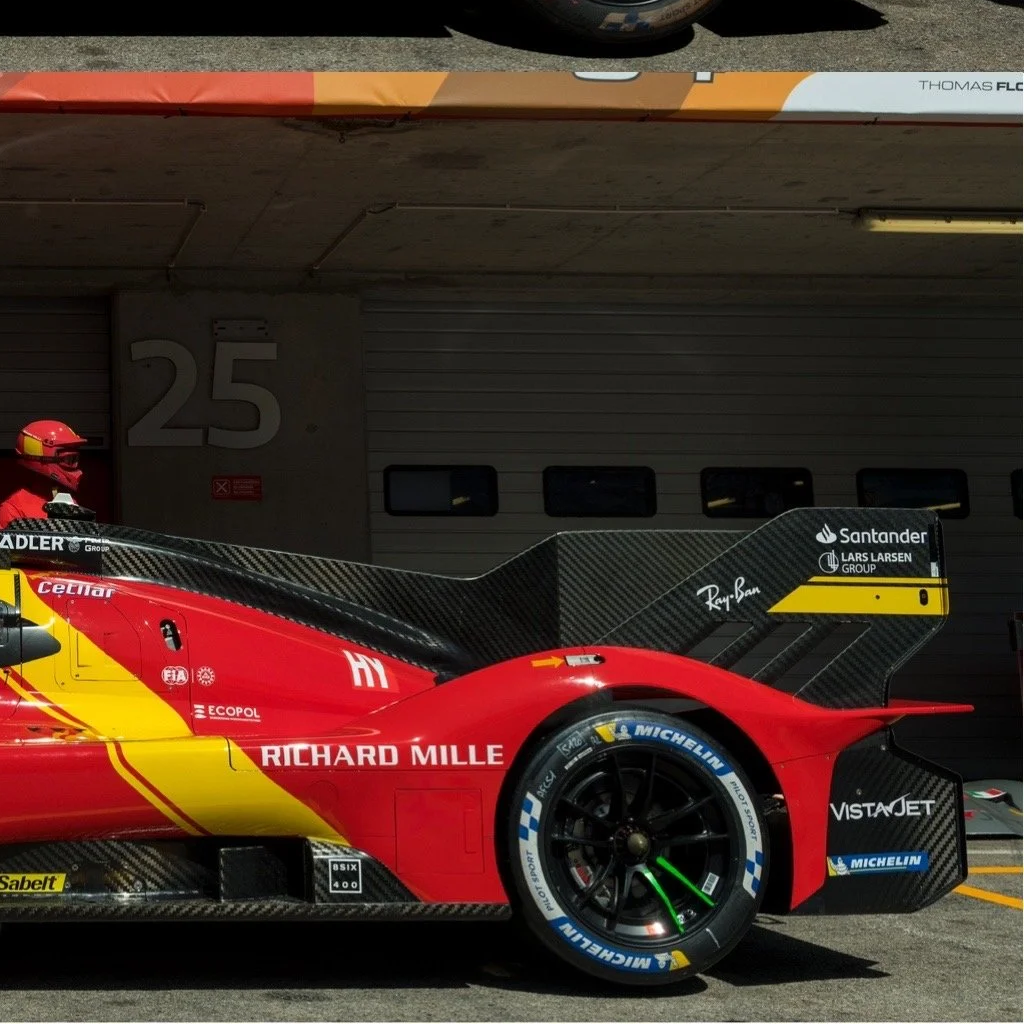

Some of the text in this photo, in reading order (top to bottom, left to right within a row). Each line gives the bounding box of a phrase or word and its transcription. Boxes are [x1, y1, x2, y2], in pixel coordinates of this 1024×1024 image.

[918, 80, 993, 91] THOMAS
[127, 339, 281, 449] 25
[840, 528, 927, 544] Santander
[842, 552, 912, 563] LARS LARSEN
[842, 563, 876, 574] GROUP
[697, 576, 760, 612] Ray-Ban
[163, 669, 186, 682] FIA
[342, 649, 388, 689] HY
[208, 705, 261, 718] ECOPOL
[634, 724, 725, 771] MICHELIN
[261, 745, 504, 767] RICHARD MILLE
[730, 781, 758, 842] PILOT SPORT
[333, 863, 357, 871] 8SIX
[850, 855, 921, 869] MICHELIN
[333, 881, 358, 889] 400
[526, 849, 555, 912] PILOT SPORT
[558, 922, 652, 970] MICHELIN
